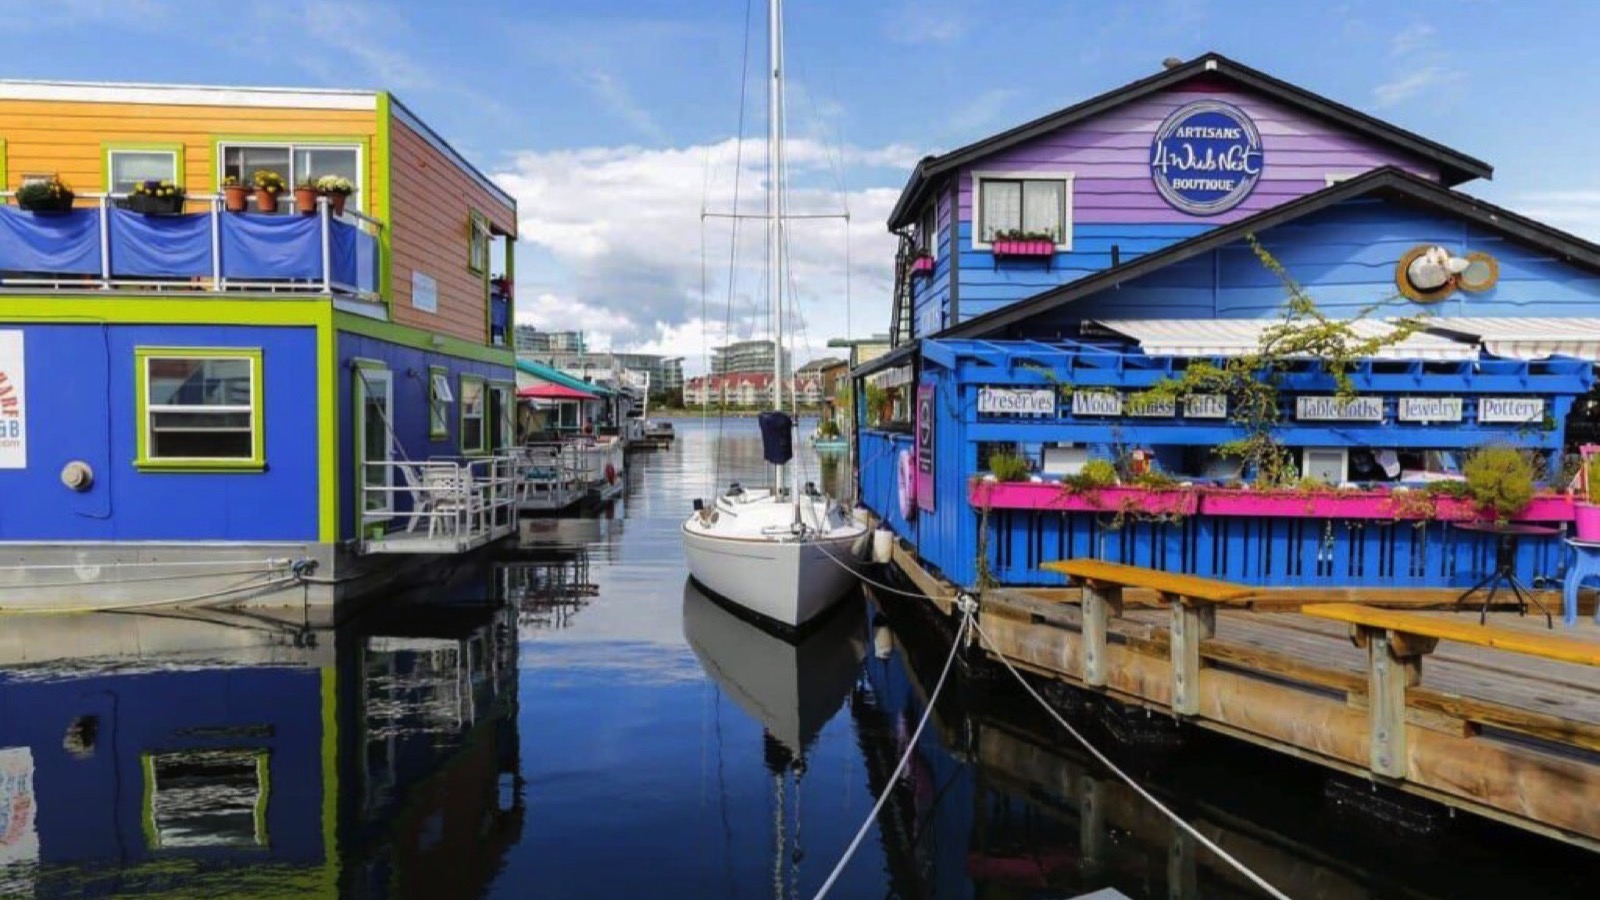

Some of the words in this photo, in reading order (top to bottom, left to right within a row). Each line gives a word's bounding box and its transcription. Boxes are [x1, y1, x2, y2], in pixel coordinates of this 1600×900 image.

[1176, 126, 1241, 139] ARTISANS
[1173, 178, 1234, 191] BOUTIQUE
[980, 389, 1053, 410] Preserves
[1077, 392, 1119, 412] Wood
[1403, 399, 1459, 419] Jewelry
[1482, 399, 1538, 419] Pottery
